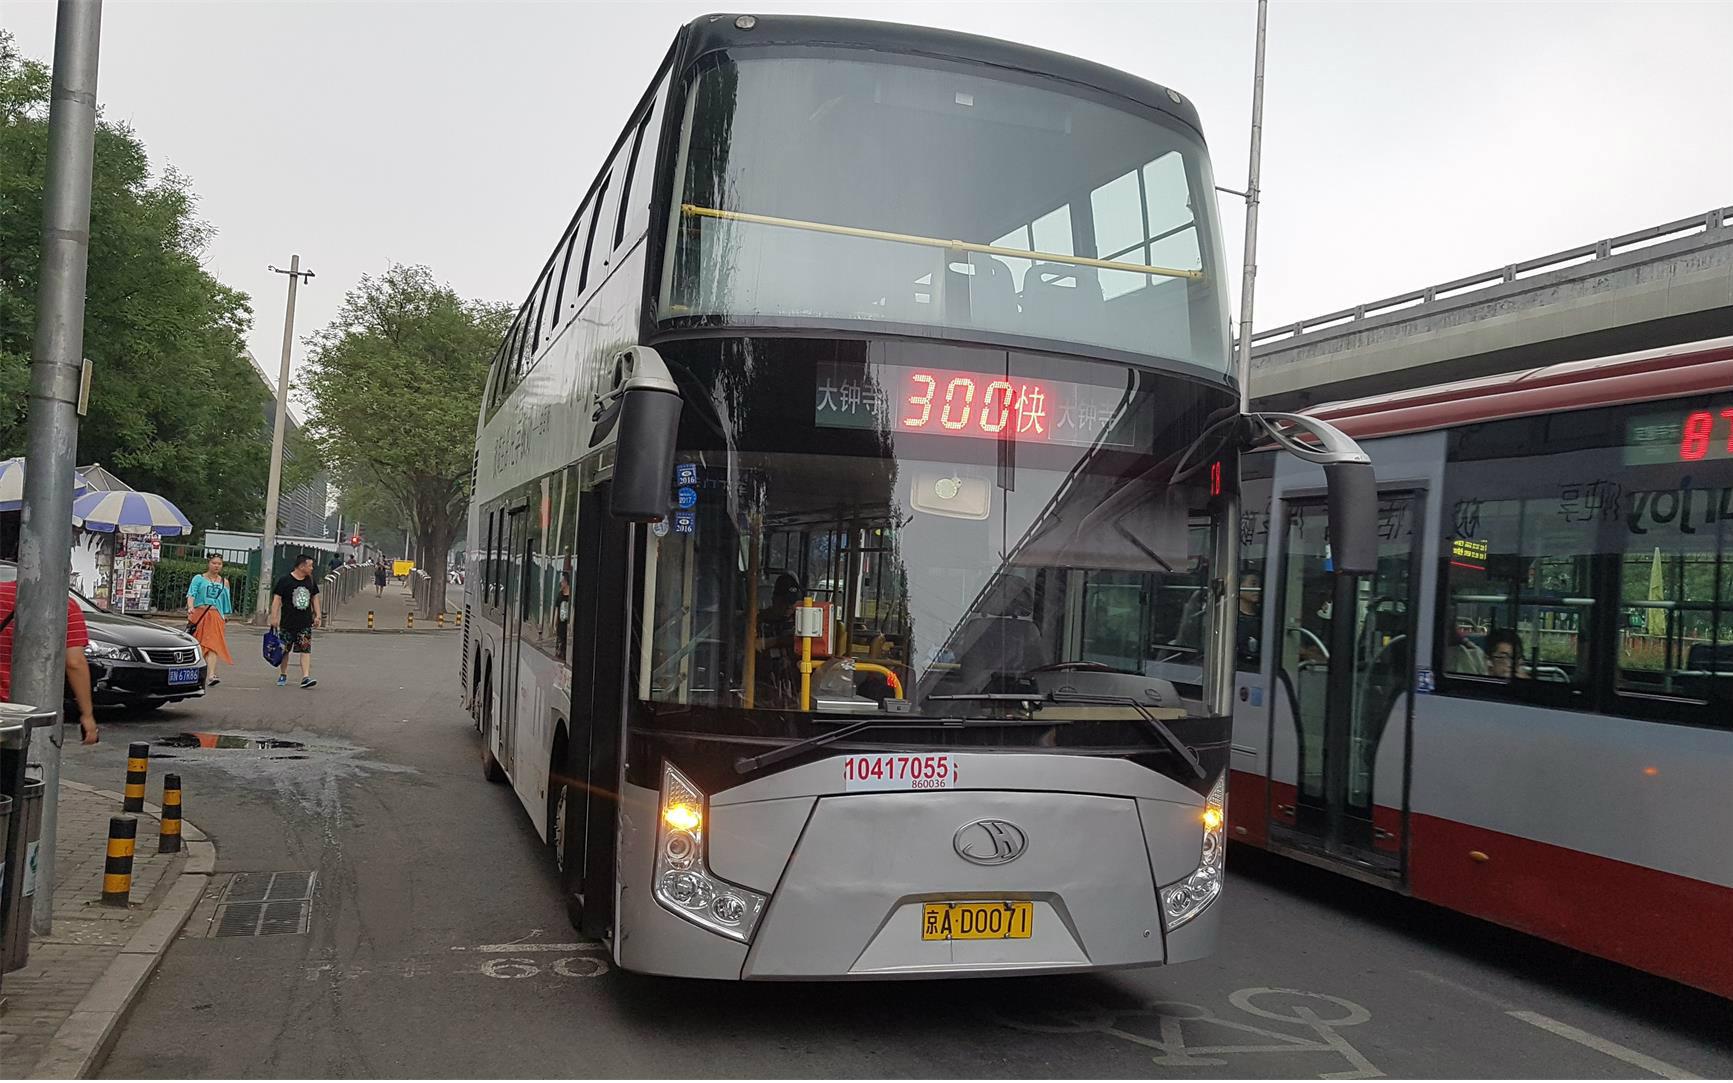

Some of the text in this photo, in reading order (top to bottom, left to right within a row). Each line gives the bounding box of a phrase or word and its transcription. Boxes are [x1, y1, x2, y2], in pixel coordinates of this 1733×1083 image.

[680, 475, 695, 485] 2016
[676, 524, 692, 533] 2016
[845, 757, 948, 780] 10417055
[911, 779, 946, 789] 860036
